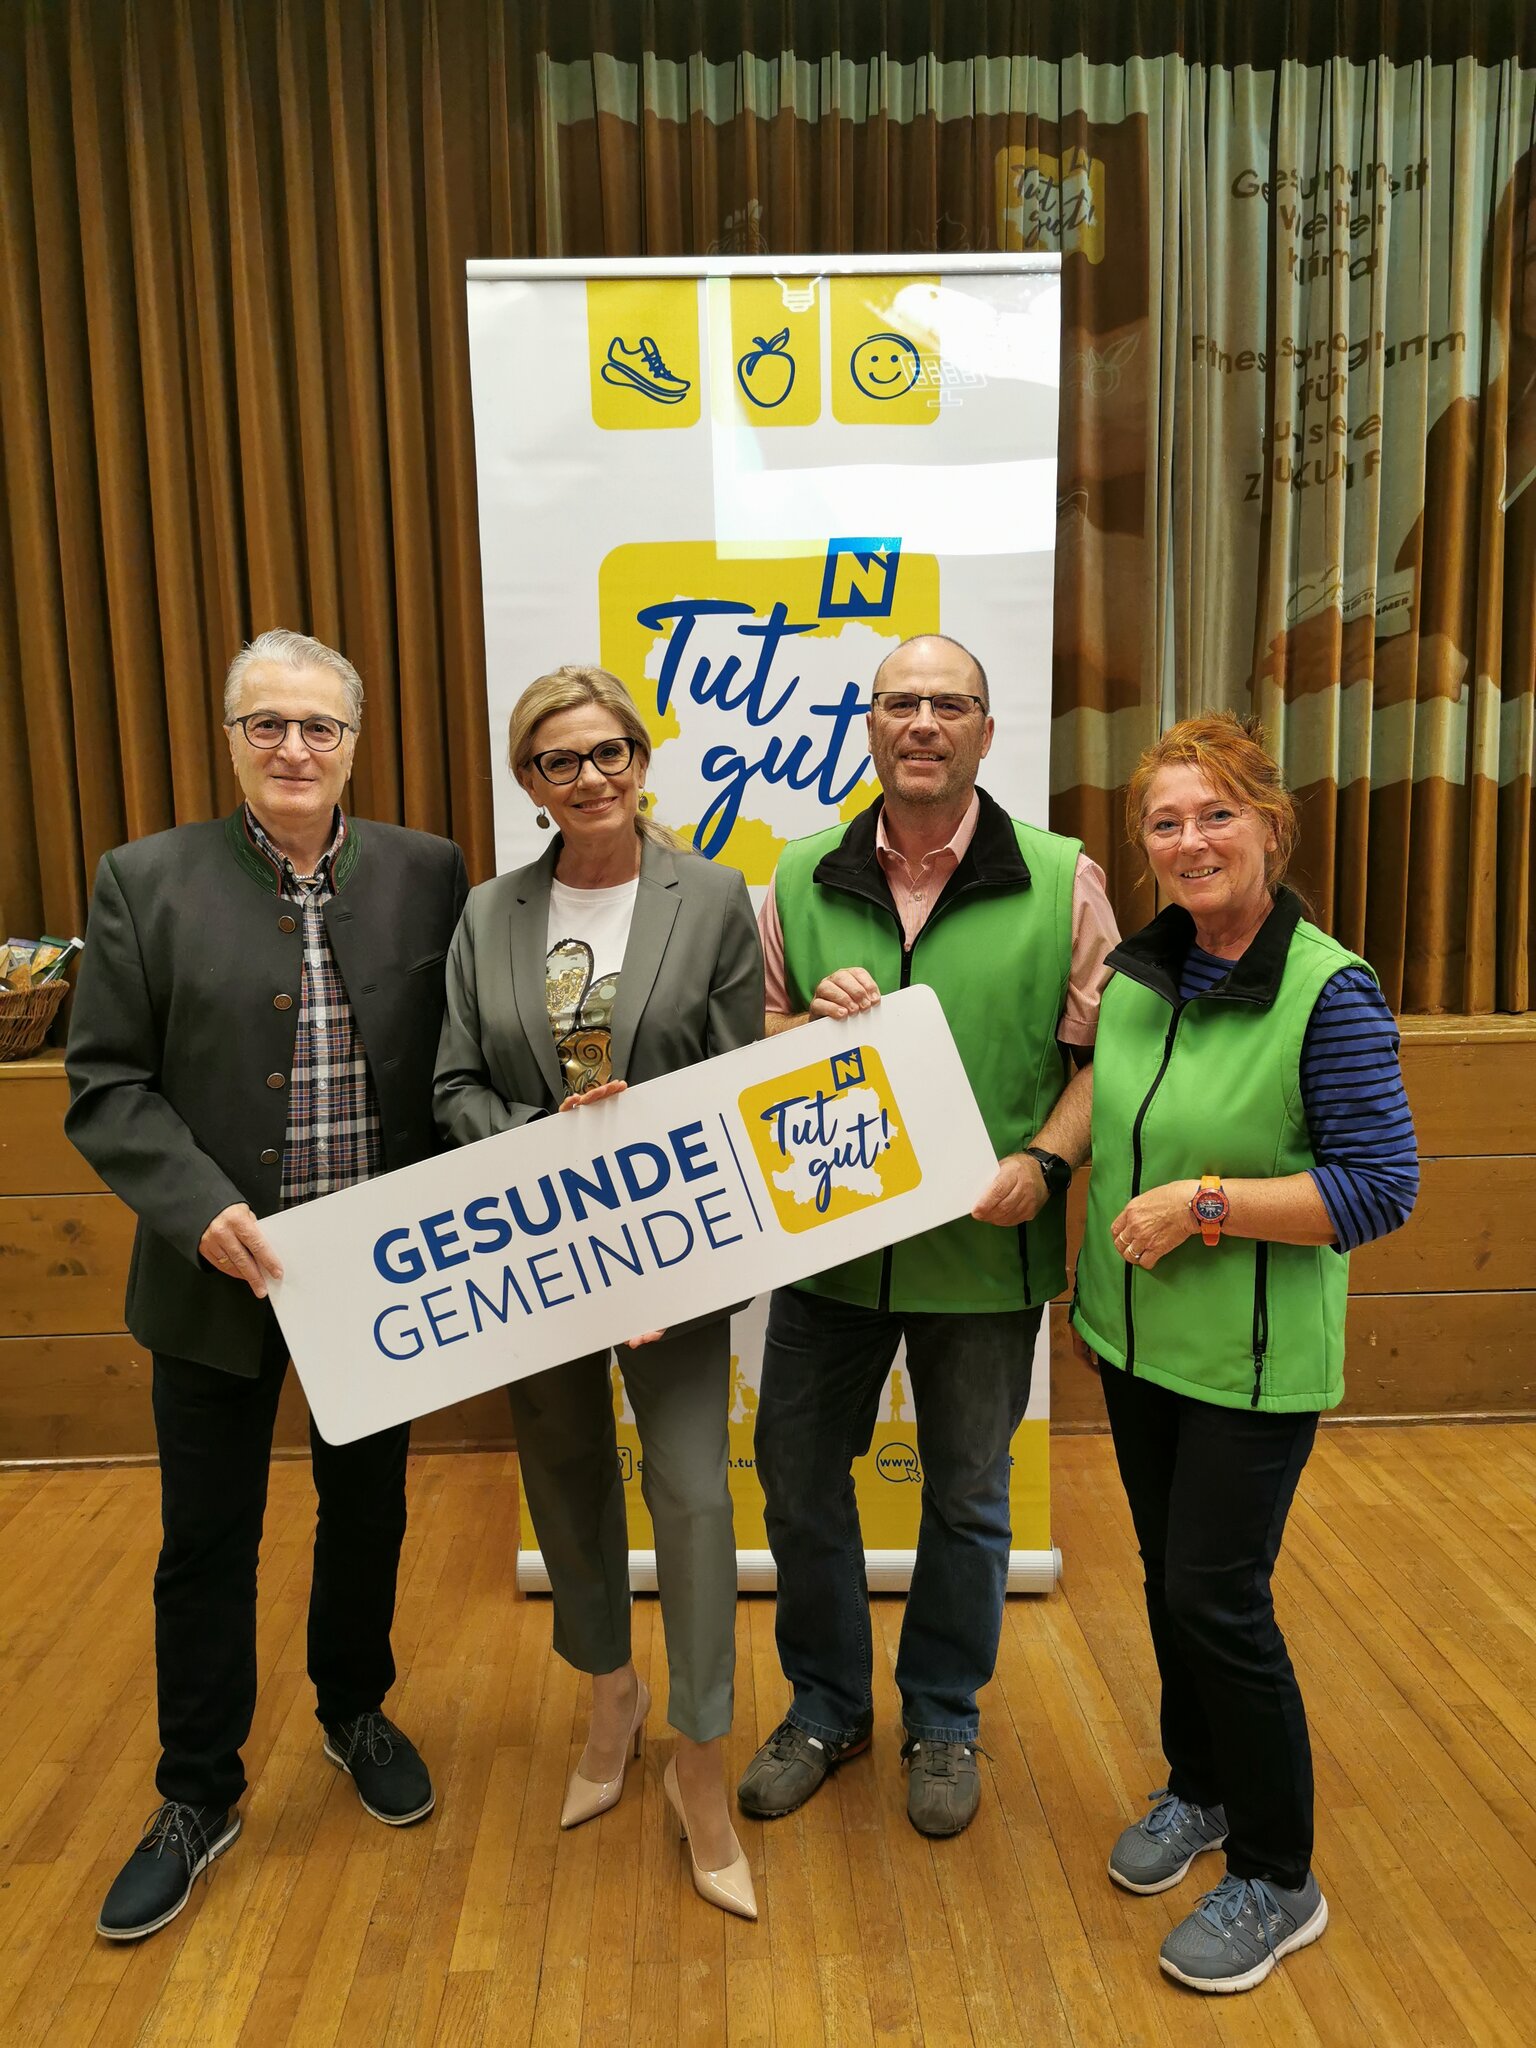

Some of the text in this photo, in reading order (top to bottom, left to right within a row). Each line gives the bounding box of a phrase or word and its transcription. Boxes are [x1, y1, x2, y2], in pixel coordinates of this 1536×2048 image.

[637, 600, 820, 727] Tut
[761, 1090, 838, 1155] Tut
[808, 1108, 890, 1214] gut!
[372, 1120, 718, 1285] GESUNDE
[372, 1188, 742, 1361] GEMEINDE
[880, 1458, 914, 1467] www
